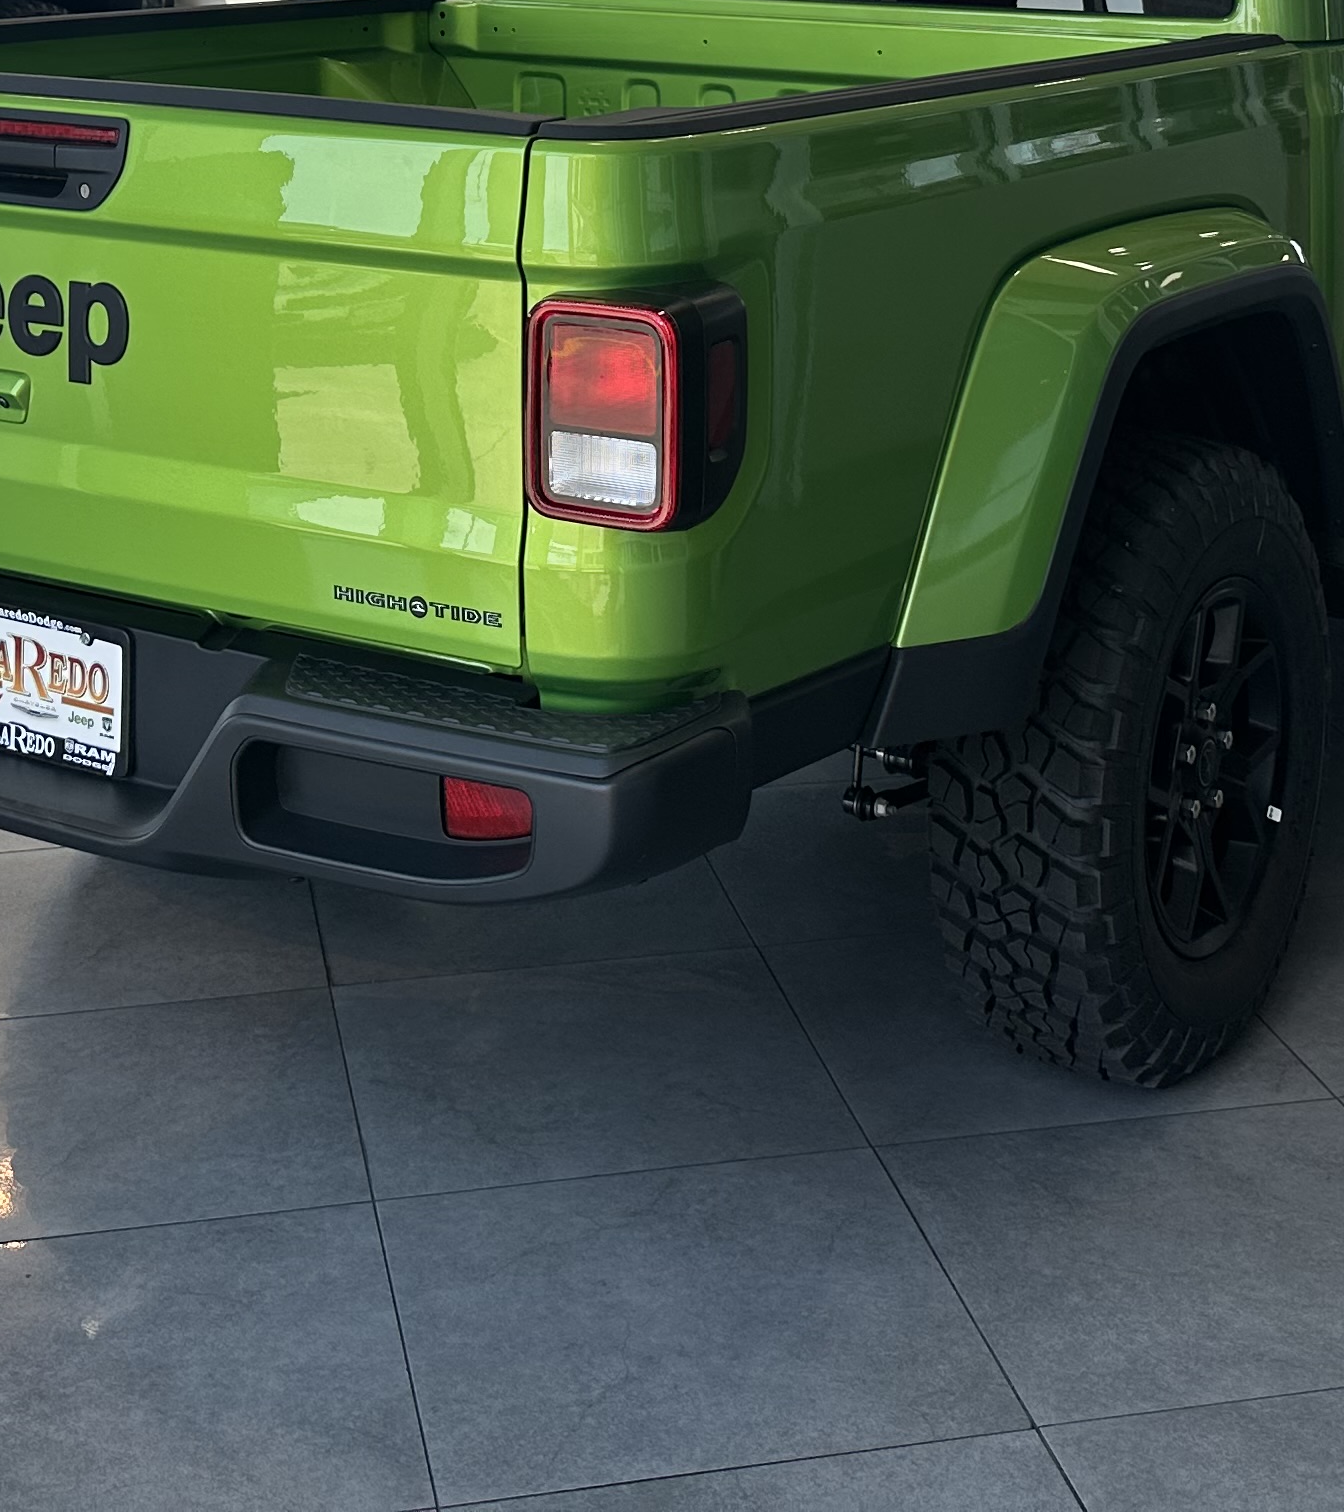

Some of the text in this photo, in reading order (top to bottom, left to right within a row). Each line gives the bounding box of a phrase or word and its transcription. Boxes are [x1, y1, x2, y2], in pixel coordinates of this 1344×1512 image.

[333, 585, 503, 628] HIGH TIDE
[68, 711, 95, 730] Jeep
[74, 742, 116, 763] RAM
[62, 754, 110, 772] DODGE
